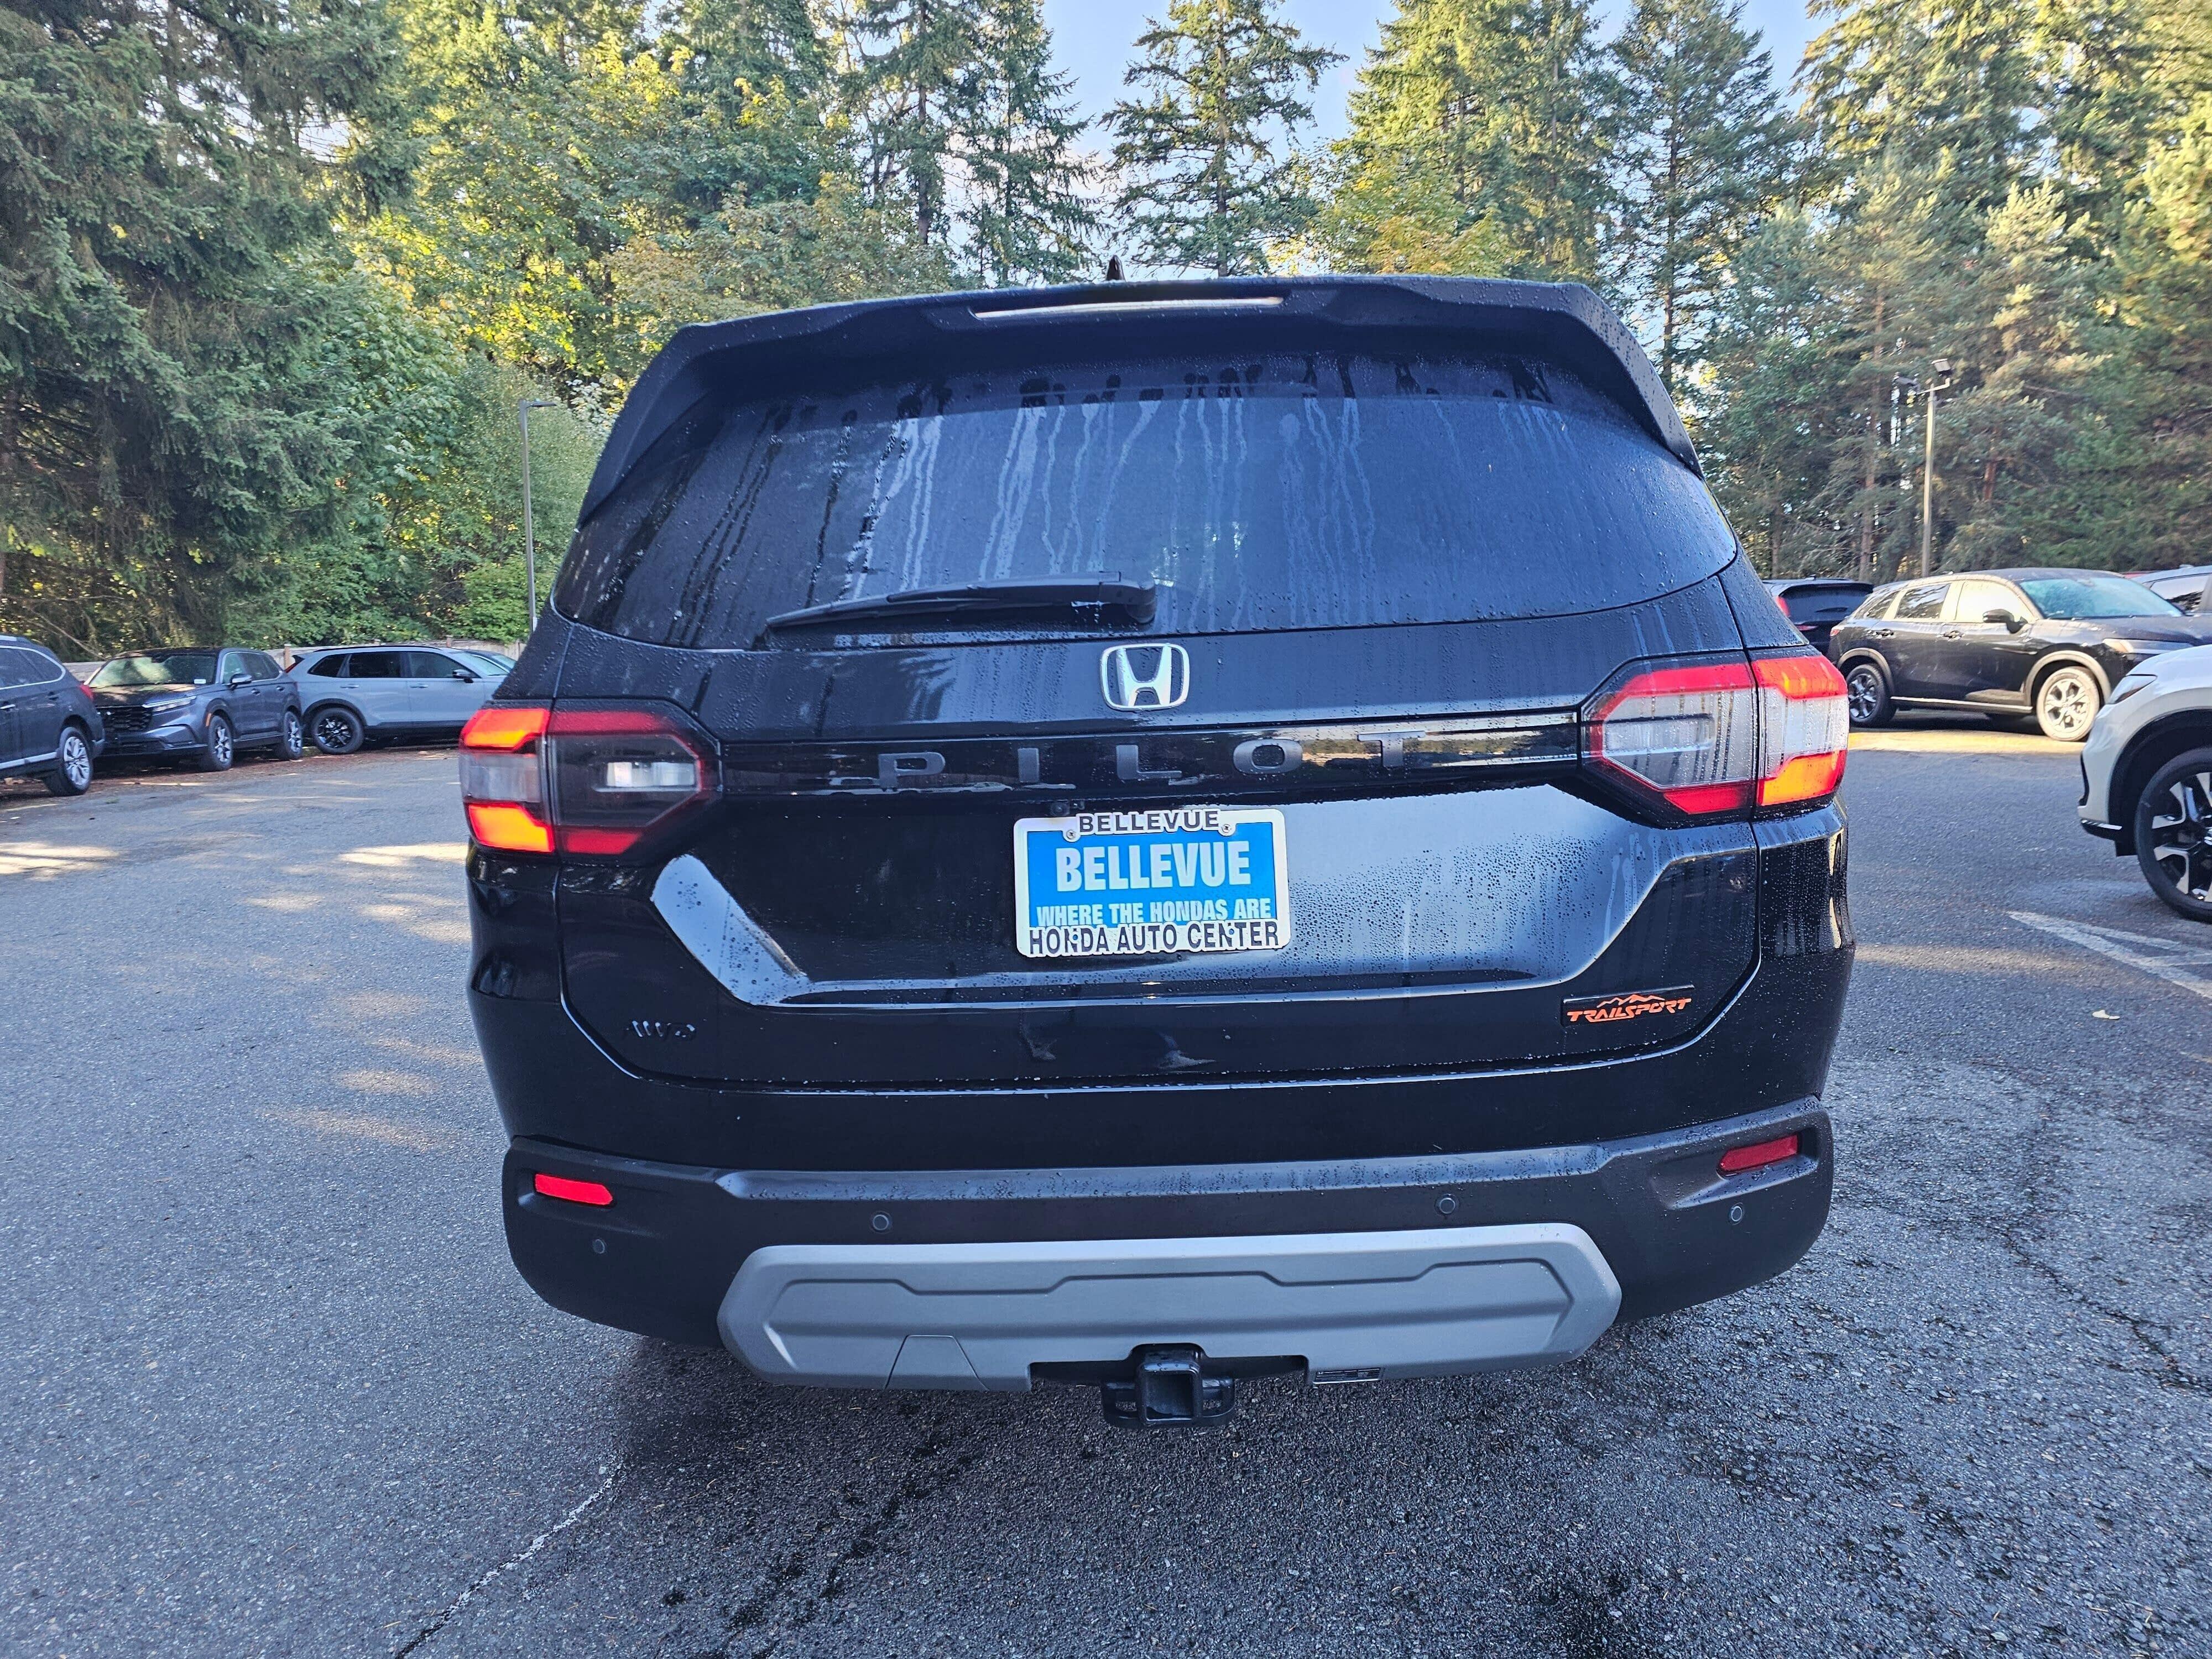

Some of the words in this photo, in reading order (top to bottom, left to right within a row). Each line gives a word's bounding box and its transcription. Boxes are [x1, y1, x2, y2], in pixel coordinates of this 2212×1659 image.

[878, 730, 1427, 790] PILOT
[1079, 811, 1218, 833] BELLEVUE
[1055, 841, 1251, 892] BELLEVUE
[1036, 903, 1103, 927] WHERE
[1109, 901, 1144, 924] THE
[1150, 899, 1228, 922] HONDAS
[1234, 898, 1271, 920] ARE
[1029, 926, 1110, 955] HONDA
[1117, 924, 1177, 951] AUTO
[1187, 921, 1279, 949] CENTER
[1567, 998, 1692, 1023] TRAILSPORT
